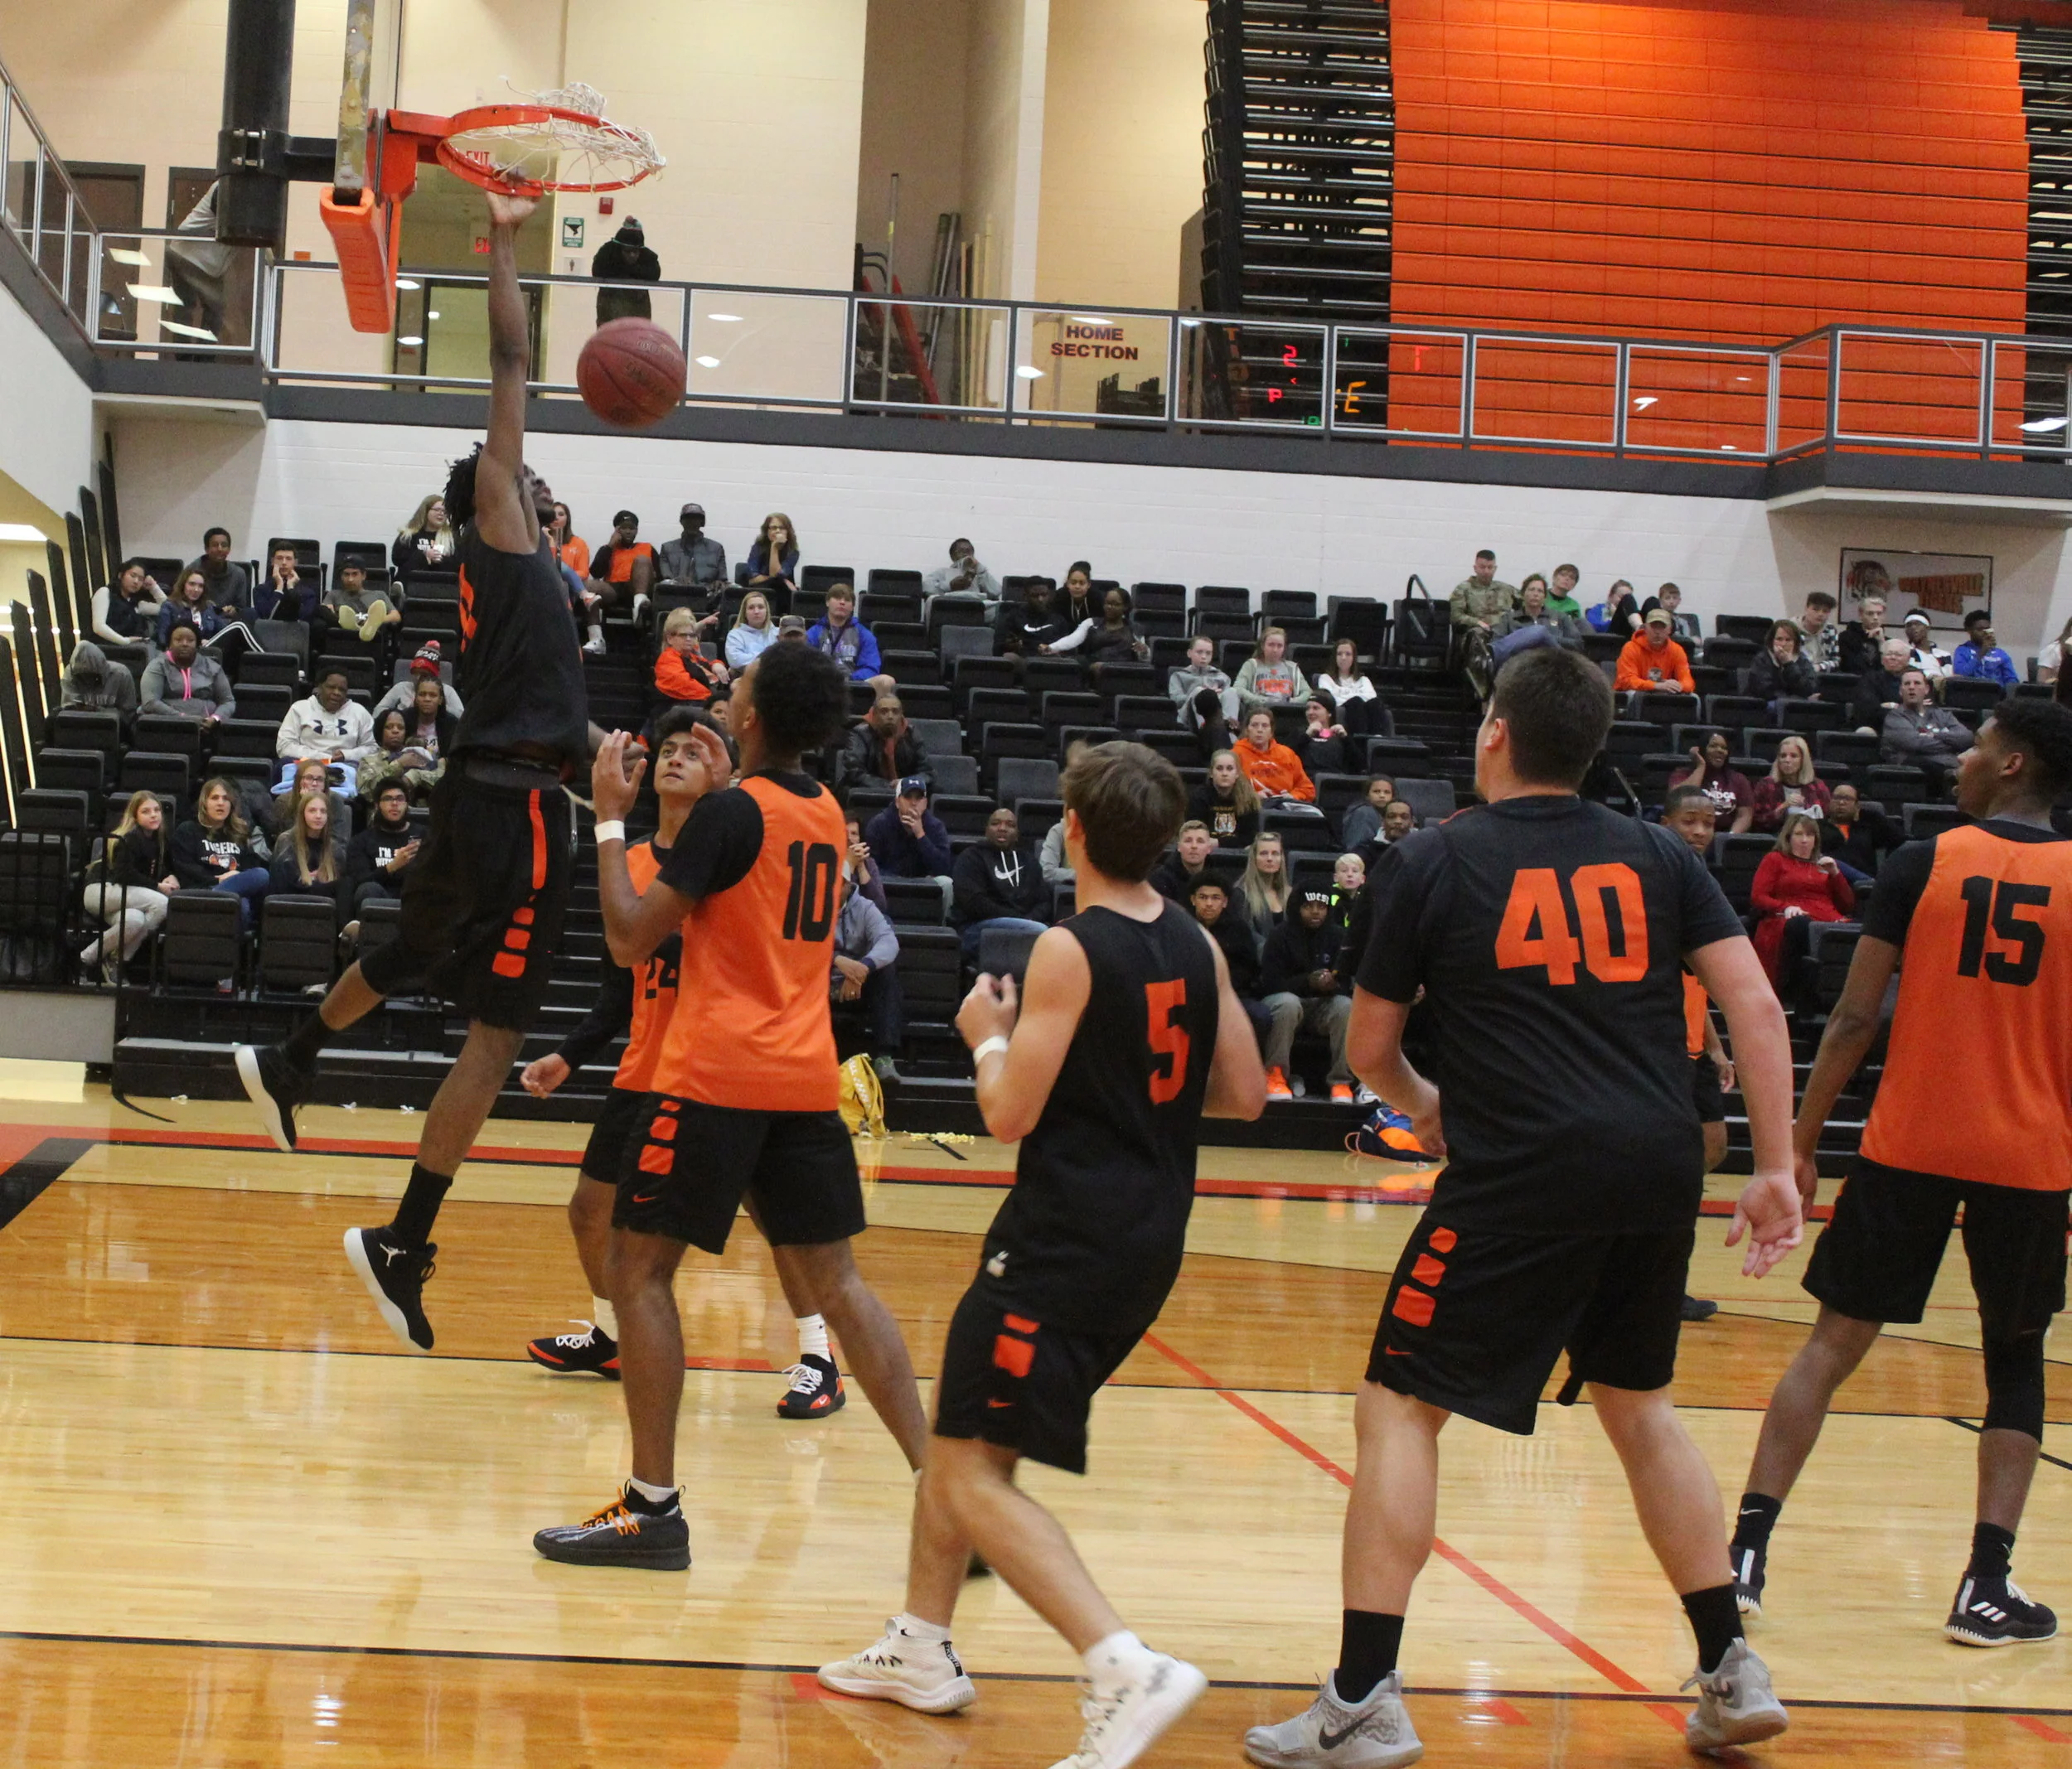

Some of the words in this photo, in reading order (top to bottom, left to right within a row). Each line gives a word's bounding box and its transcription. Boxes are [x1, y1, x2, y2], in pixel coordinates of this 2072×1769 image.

[475, 237, 491, 254] EX
[1051, 342, 1139, 360] SECTION
[1066, 325, 1124, 341] HOME
[201, 839, 241, 855] TIGERS
[782, 839, 838, 942] 10
[1494, 862, 1648, 986] 40
[1958, 875, 2051, 987] 15
[1145, 978, 1190, 1105] 5
